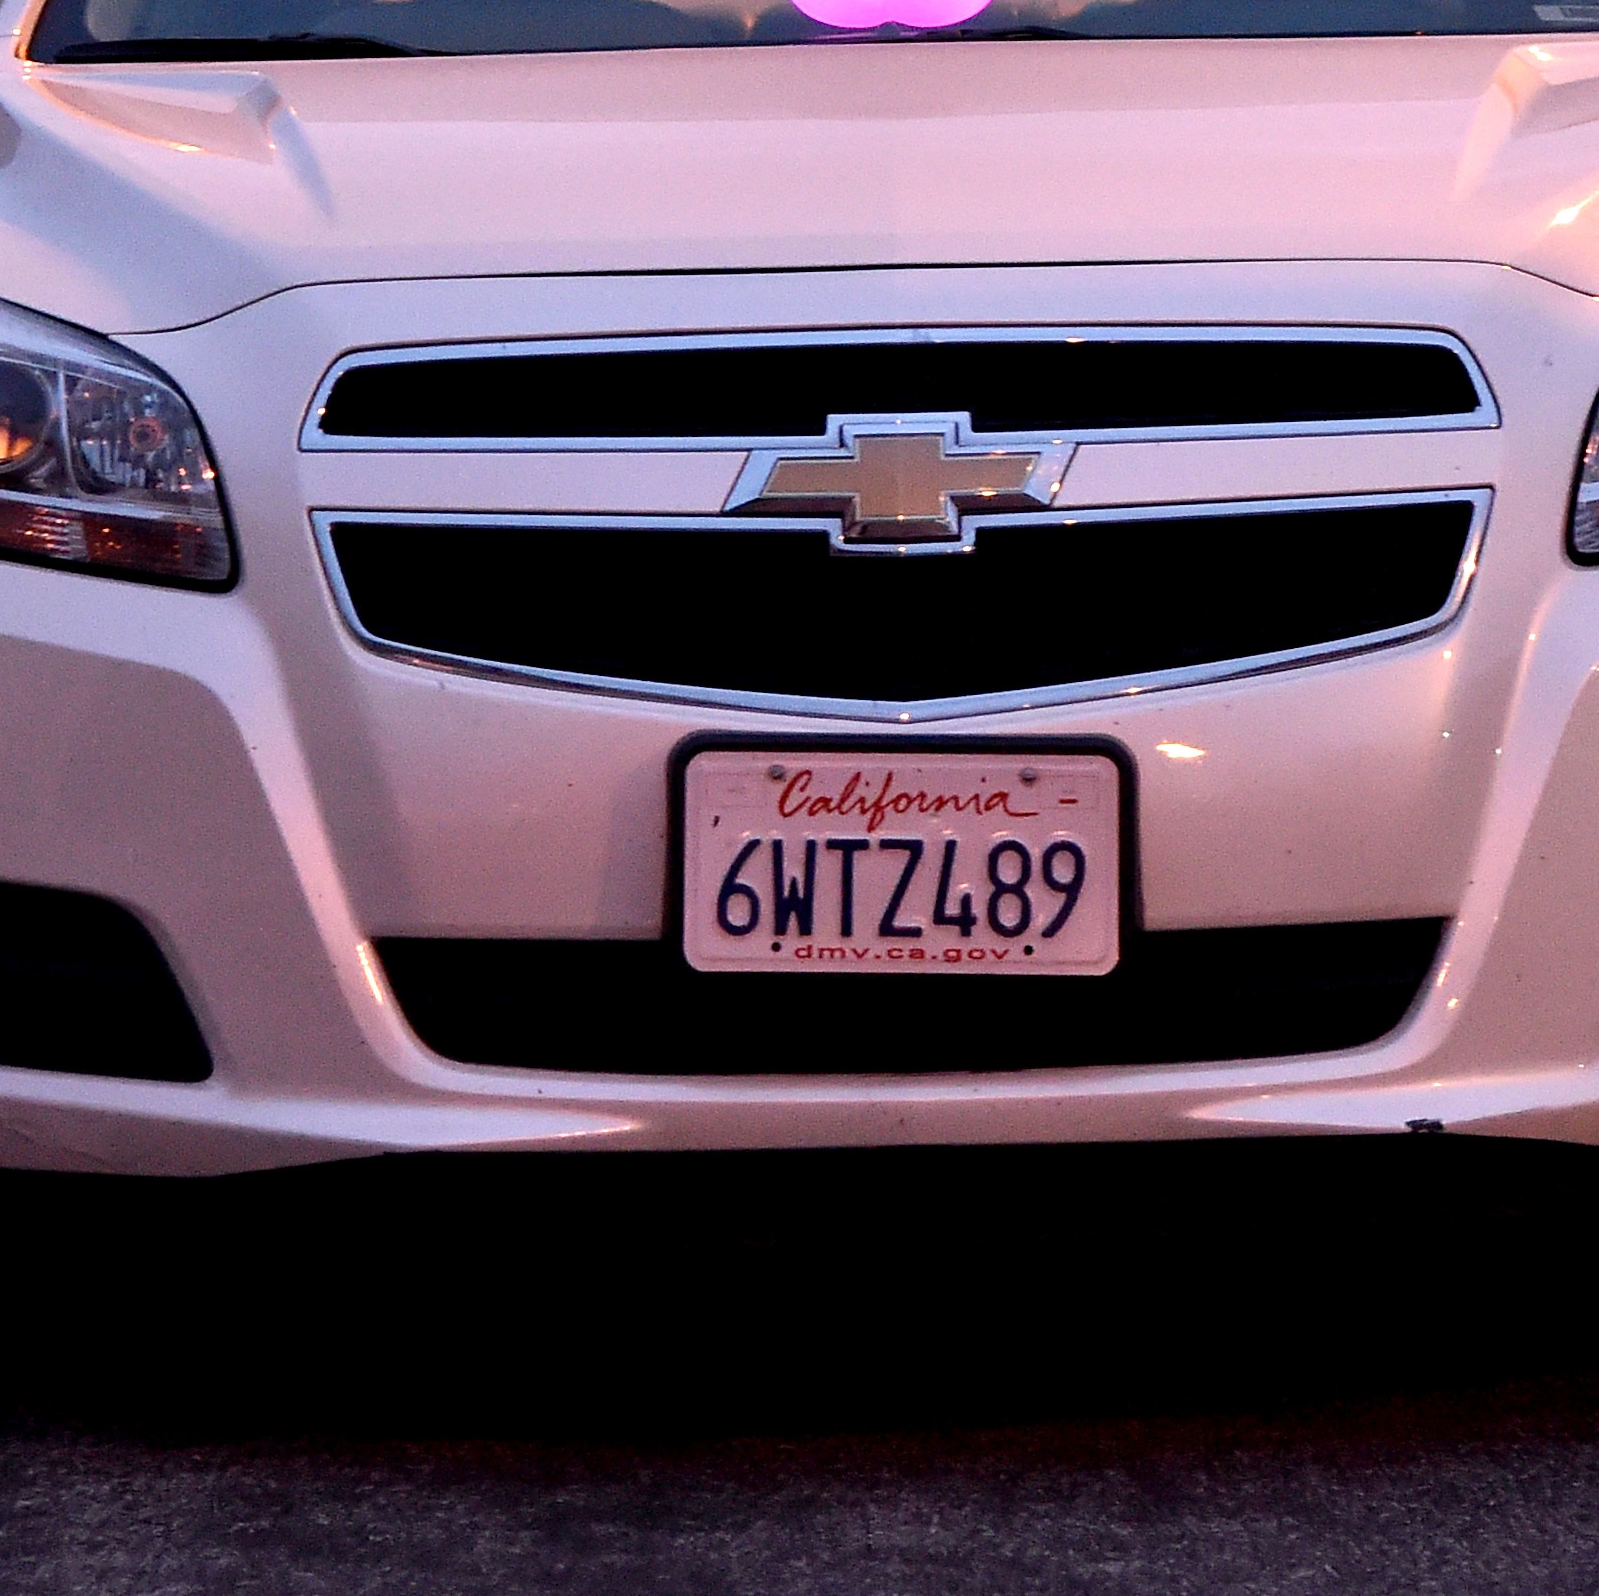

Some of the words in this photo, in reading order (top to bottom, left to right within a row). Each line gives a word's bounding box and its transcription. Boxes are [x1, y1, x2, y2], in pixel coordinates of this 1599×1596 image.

[778, 769, 1039, 833] California
[716, 838, 1086, 939] 6WTZ489
[793, 942, 1010, 963] dmv.ca.gov
